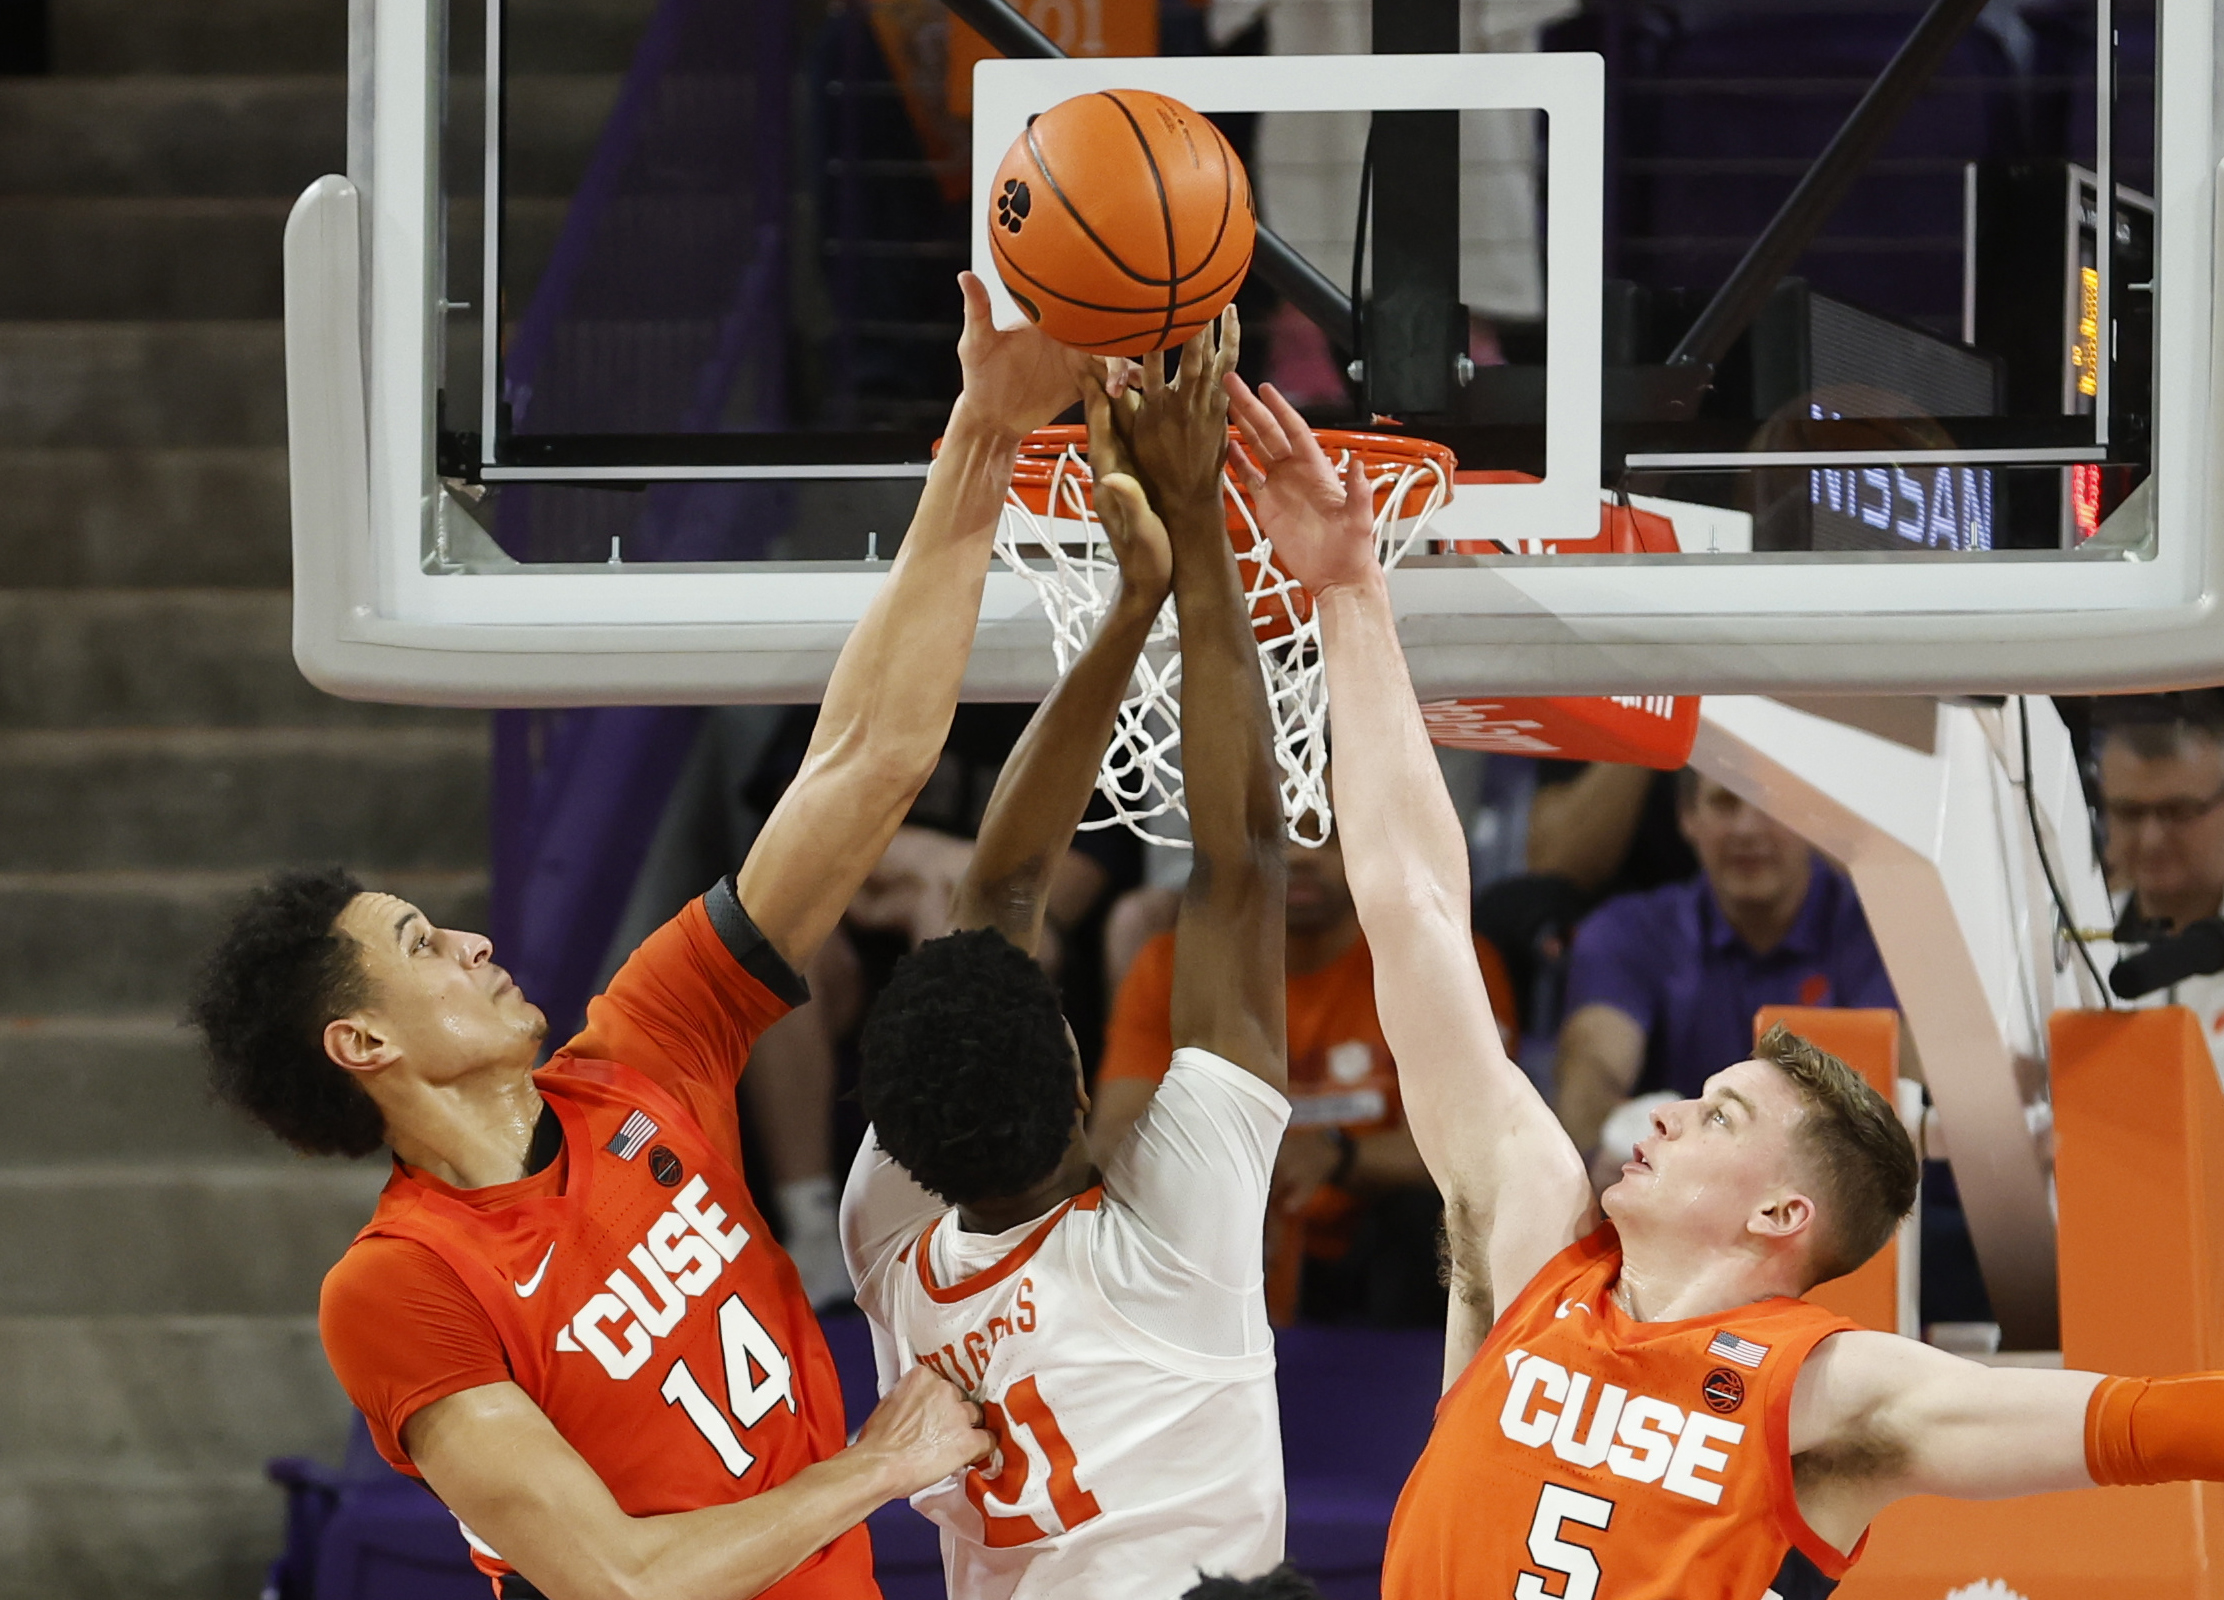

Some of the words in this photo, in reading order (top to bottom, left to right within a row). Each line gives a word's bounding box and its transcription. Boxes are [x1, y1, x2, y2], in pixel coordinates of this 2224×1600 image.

[1811, 467, 1992, 550] NISSAN
[660, 1291, 797, 1479] 14
[1513, 1480, 1616, 1600] 5
